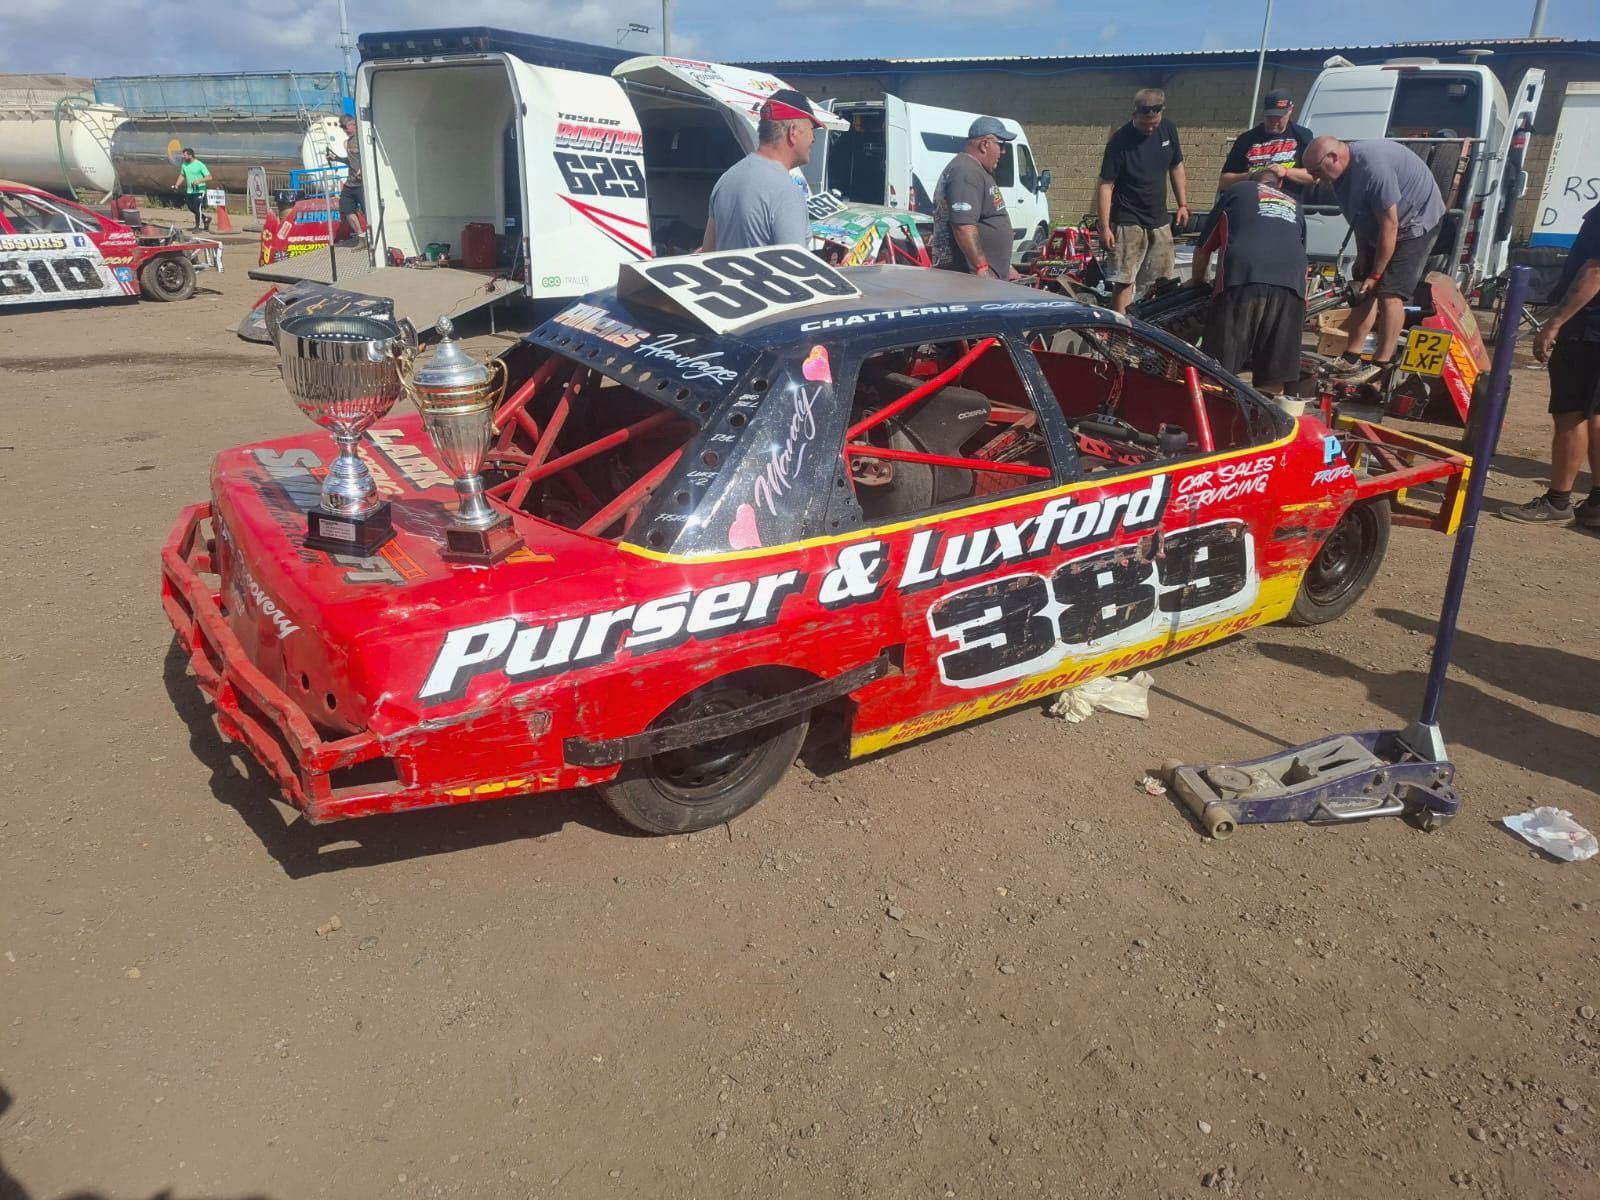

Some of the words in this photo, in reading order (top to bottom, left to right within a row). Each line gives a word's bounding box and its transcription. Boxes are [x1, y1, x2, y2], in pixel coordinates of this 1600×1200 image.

[557, 112, 621, 126] TAYLOR
[553, 151, 647, 199] 629
[541, 275, 561, 288] eco
[645, 248, 860, 321] 389
[800, 304, 969, 332] CHATTERIS
[1403, 351, 1443, 371] LXF
[1414, 333, 1442, 352] P2
[1177, 471, 1214, 494] CAR
[1218, 455, 1277, 483] SALES
[1171, 475, 1269, 513] SERVICING
[416, 567, 806, 703] Purser
[817, 540, 892, 608] &
[898, 472, 1172, 593] Luxford
[928, 517, 1260, 690] 389
[988, 661, 1104, 711] CHARLIE
